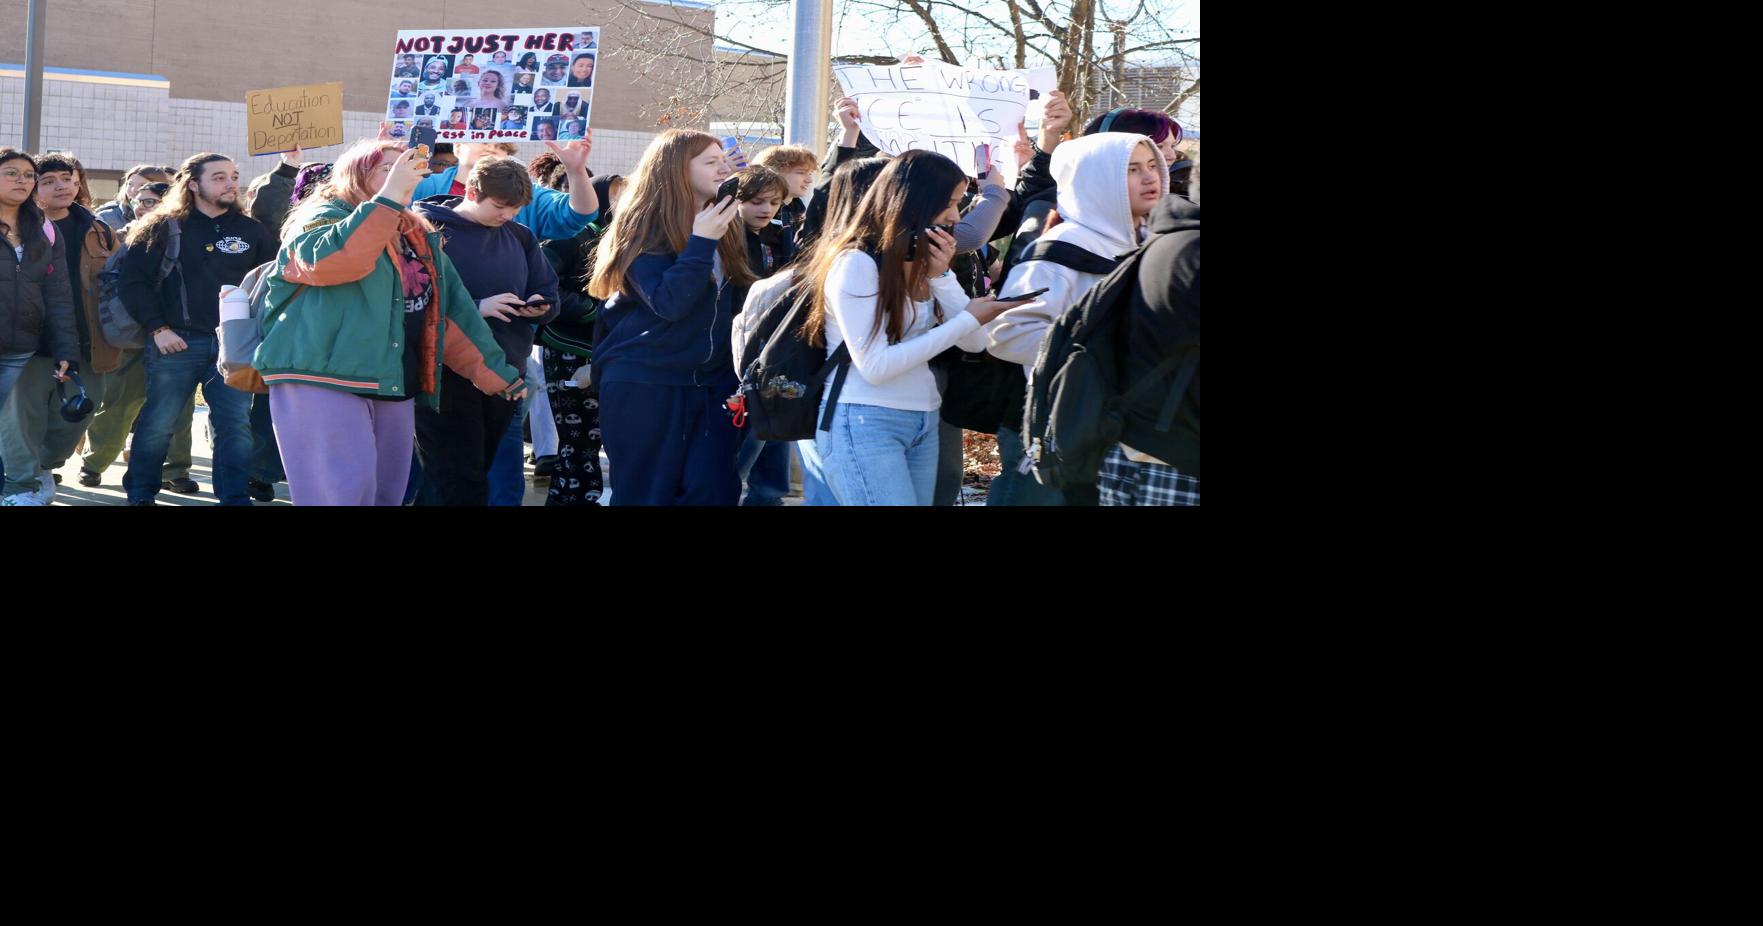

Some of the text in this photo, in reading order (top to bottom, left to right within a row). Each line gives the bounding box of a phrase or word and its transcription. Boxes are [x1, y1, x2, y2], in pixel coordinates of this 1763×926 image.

[396, 32, 575, 54] NOT JUST HER
[834, 65, 924, 90] THE
[251, 88, 331, 115] Education
[272, 110, 304, 128] NOT
[957, 105, 1001, 134] IS
[471, 131, 484, 139] in
